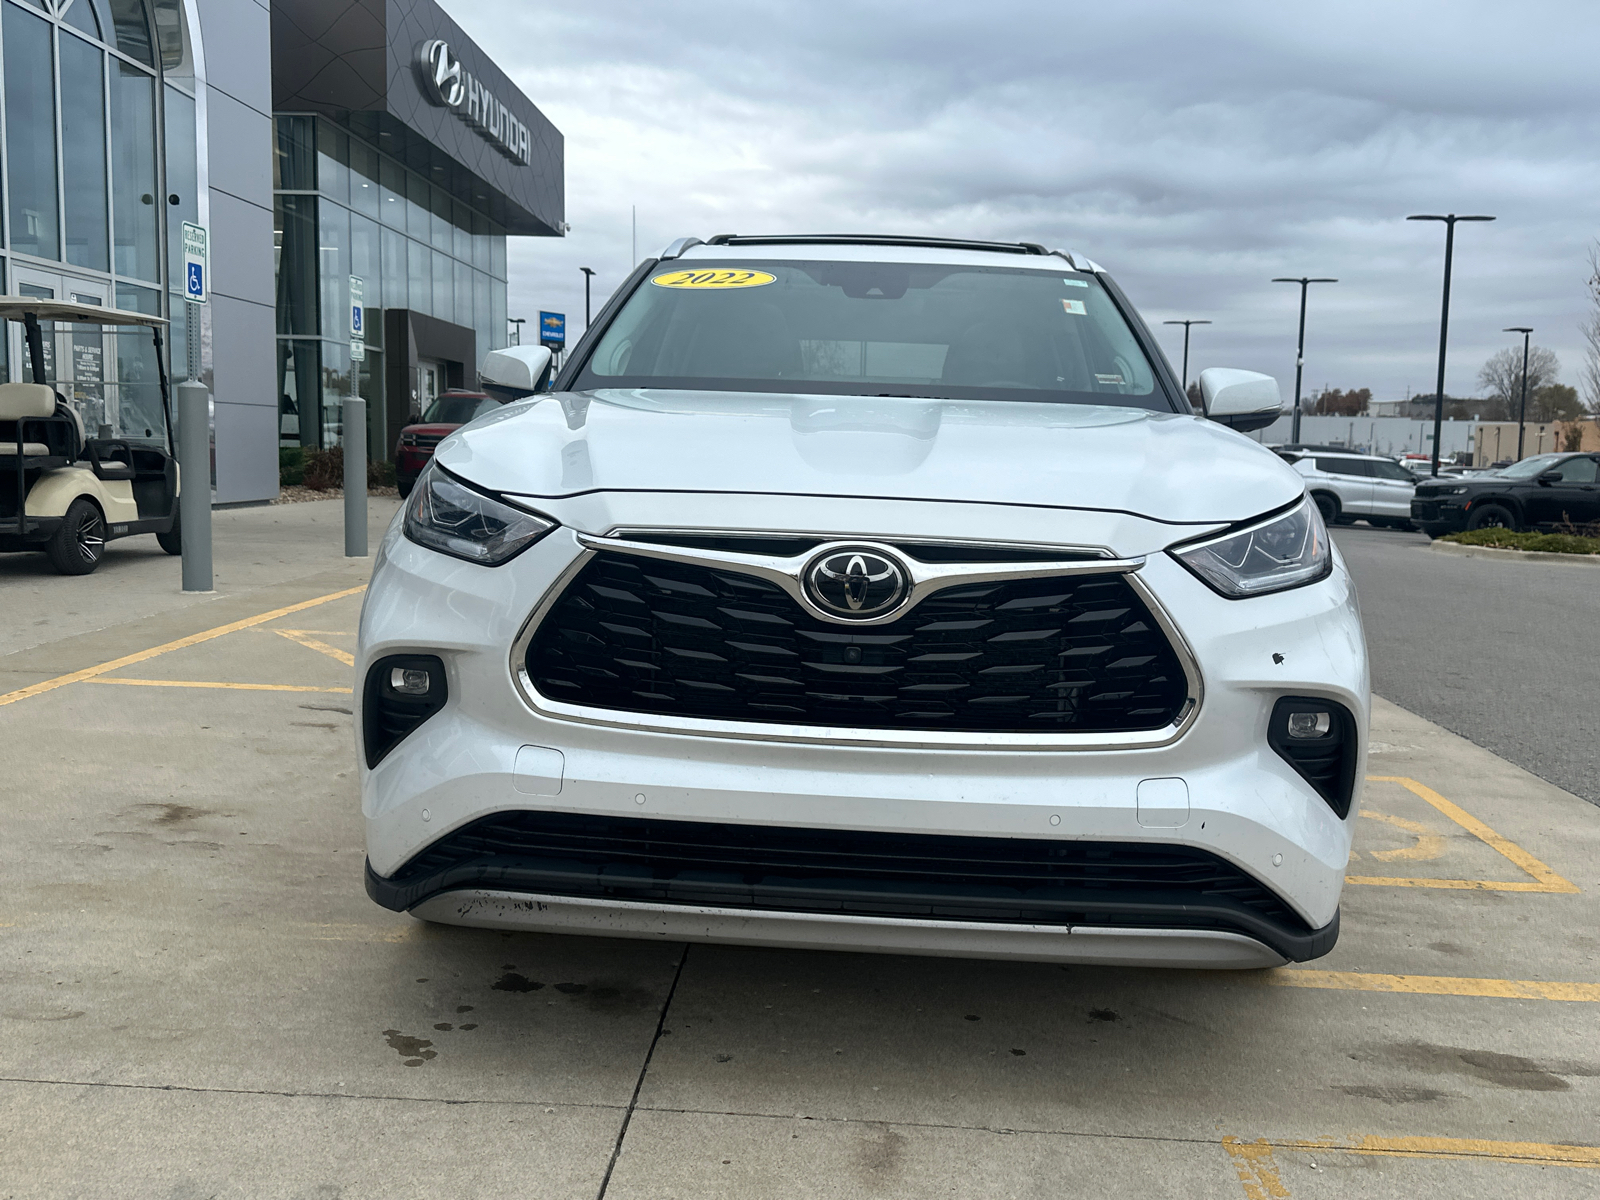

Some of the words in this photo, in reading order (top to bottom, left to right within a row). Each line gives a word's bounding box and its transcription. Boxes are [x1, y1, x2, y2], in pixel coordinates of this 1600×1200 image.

[466, 71, 531, 166] HYUNDAI
[184, 229, 205, 245] RESERVED
[184, 243, 205, 257] PARKING
[668, 272, 756, 285] 2022
